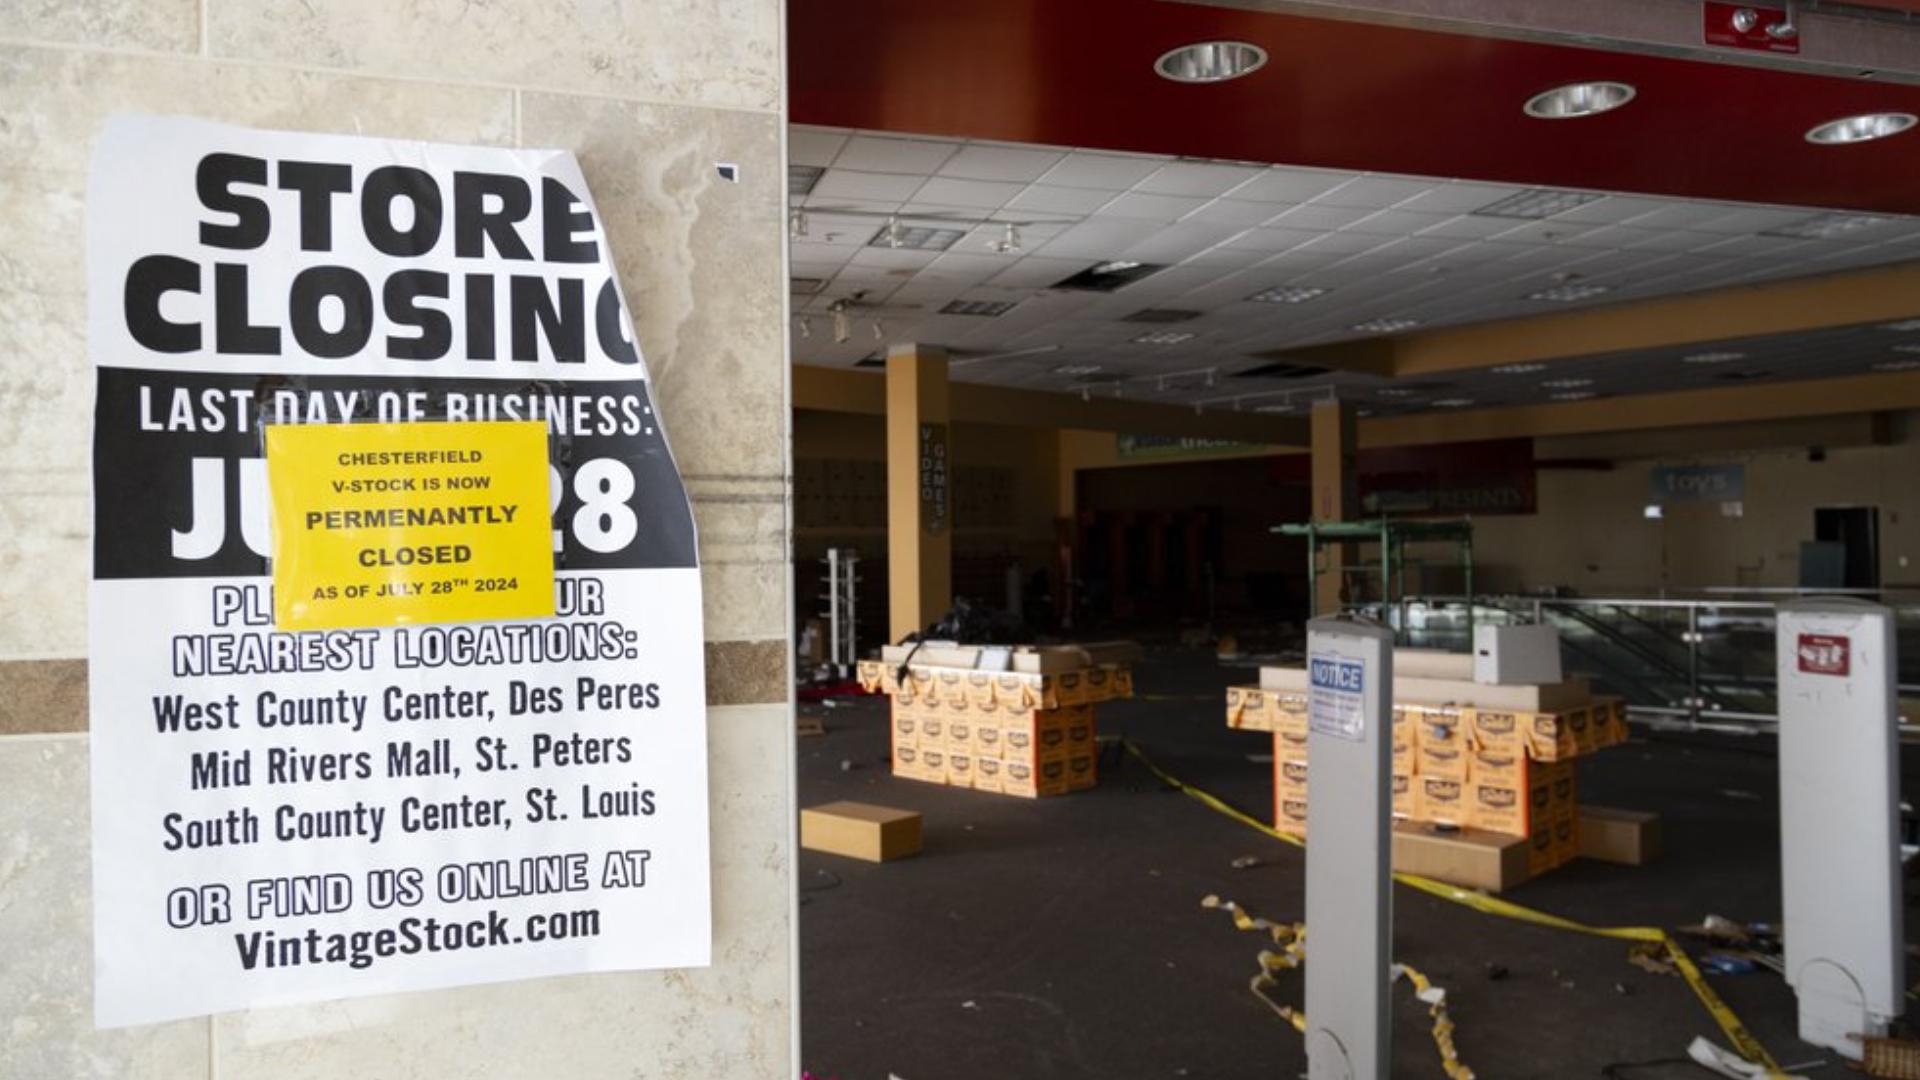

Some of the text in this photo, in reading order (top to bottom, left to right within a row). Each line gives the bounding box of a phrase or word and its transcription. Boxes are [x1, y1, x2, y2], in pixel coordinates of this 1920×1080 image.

[195, 153, 598, 263] STORE
[141, 387, 653, 435] LAST DAY OF BUSINESS:
[332, 476, 491, 493] V-STOCK IS NOW
[338, 450, 483, 466] CHESTERFIELD
[922, 427, 933, 500] VIDEO
[934, 444, 945, 517] GAMES
[306, 505, 518, 529] PERMENANTLY
[549, 458, 637, 553] 8
[358, 545, 472, 567] CLOSED
[312, 587, 338, 600] AS
[345, 585, 369, 598] OF
[376, 583, 424, 597] JULY
[475, 578, 518, 592] 2024
[173, 622, 637, 677] NEAREST LOCATIONS:
[1313, 662, 1361, 689] NOTICE
[153, 678, 659, 732] West County Center, Des Peres
[192, 733, 631, 789] Mid Rivers Mall, St. Peters
[164, 783, 655, 850] South County Center, St. Louis
[168, 850, 650, 928] OR FIND US ONLINE AT
[235, 911, 600, 969] VintageStock.com
